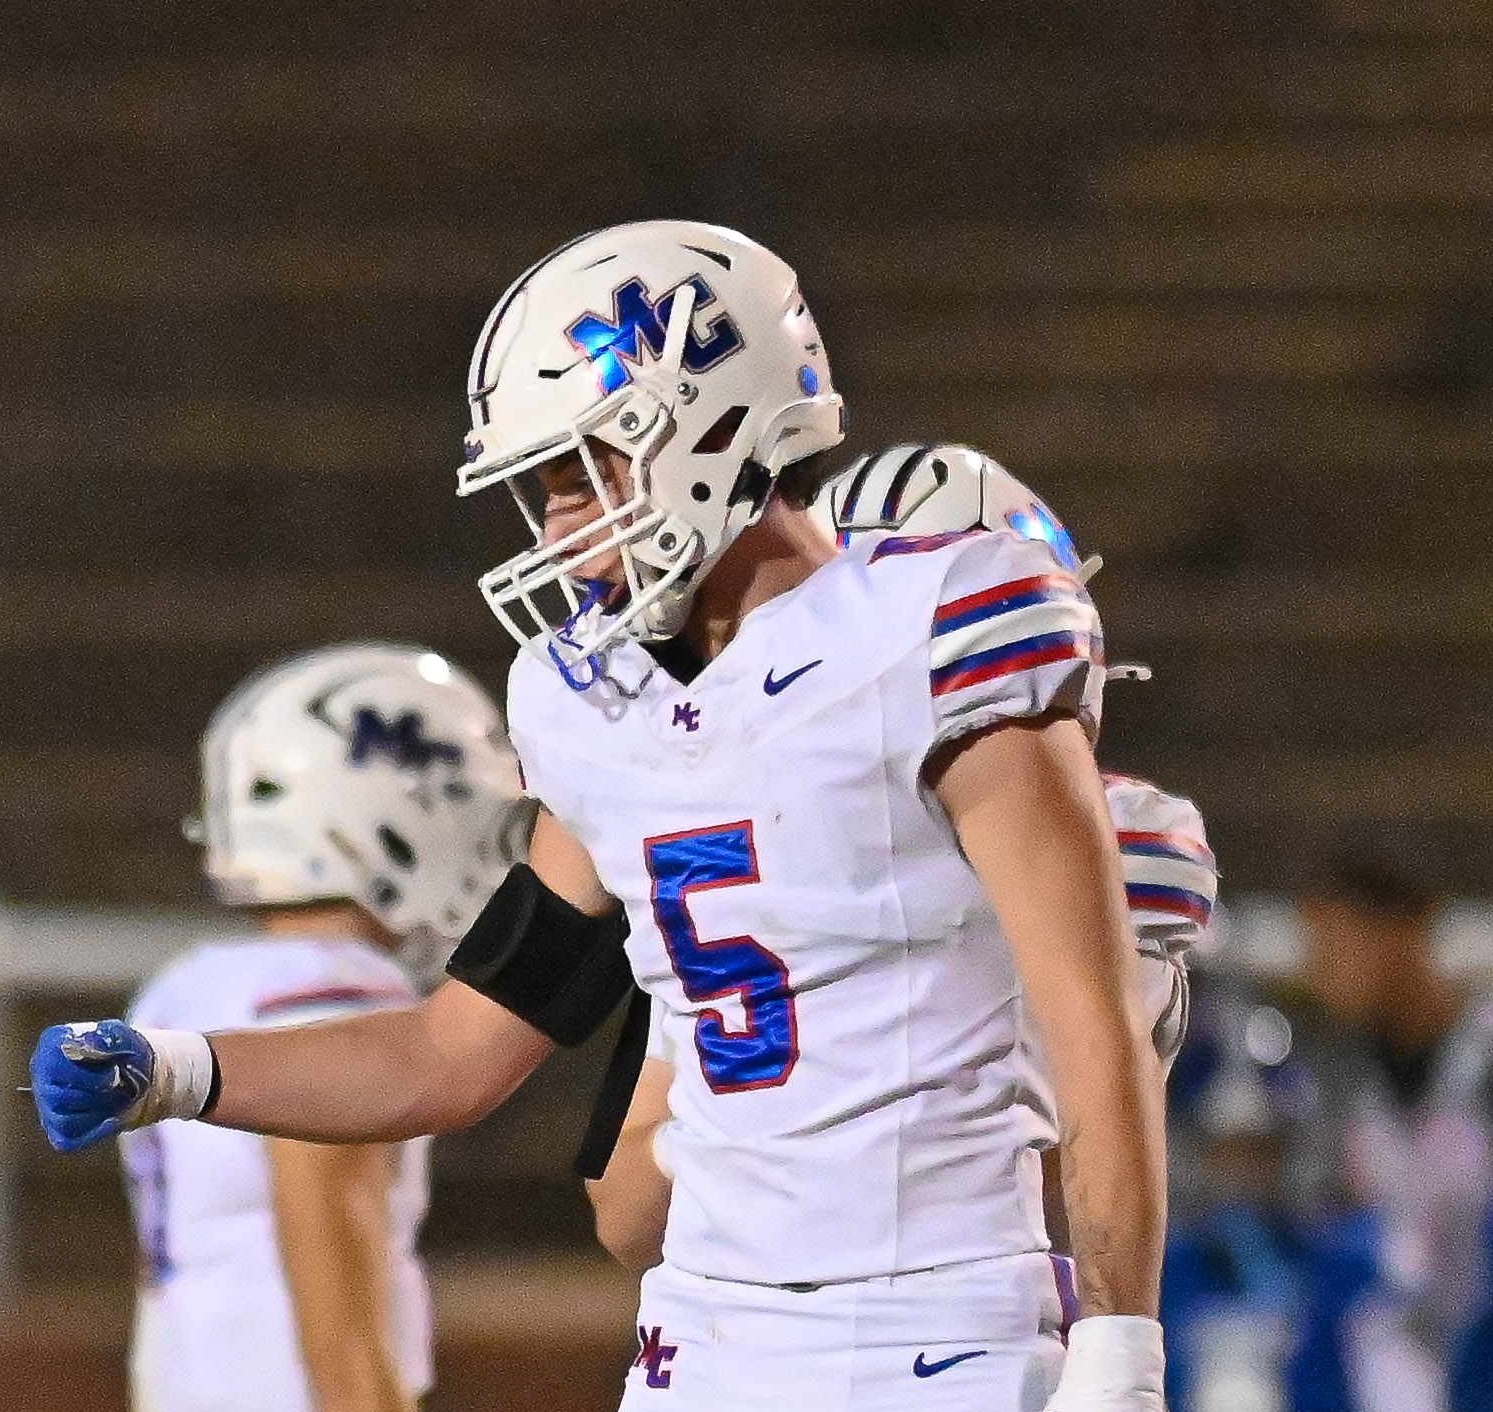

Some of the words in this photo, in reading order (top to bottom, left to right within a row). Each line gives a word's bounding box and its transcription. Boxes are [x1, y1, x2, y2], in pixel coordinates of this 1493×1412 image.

[563, 272, 747, 398] MC
[671, 701, 701, 732] MC
[642, 818, 800, 1095] 5
